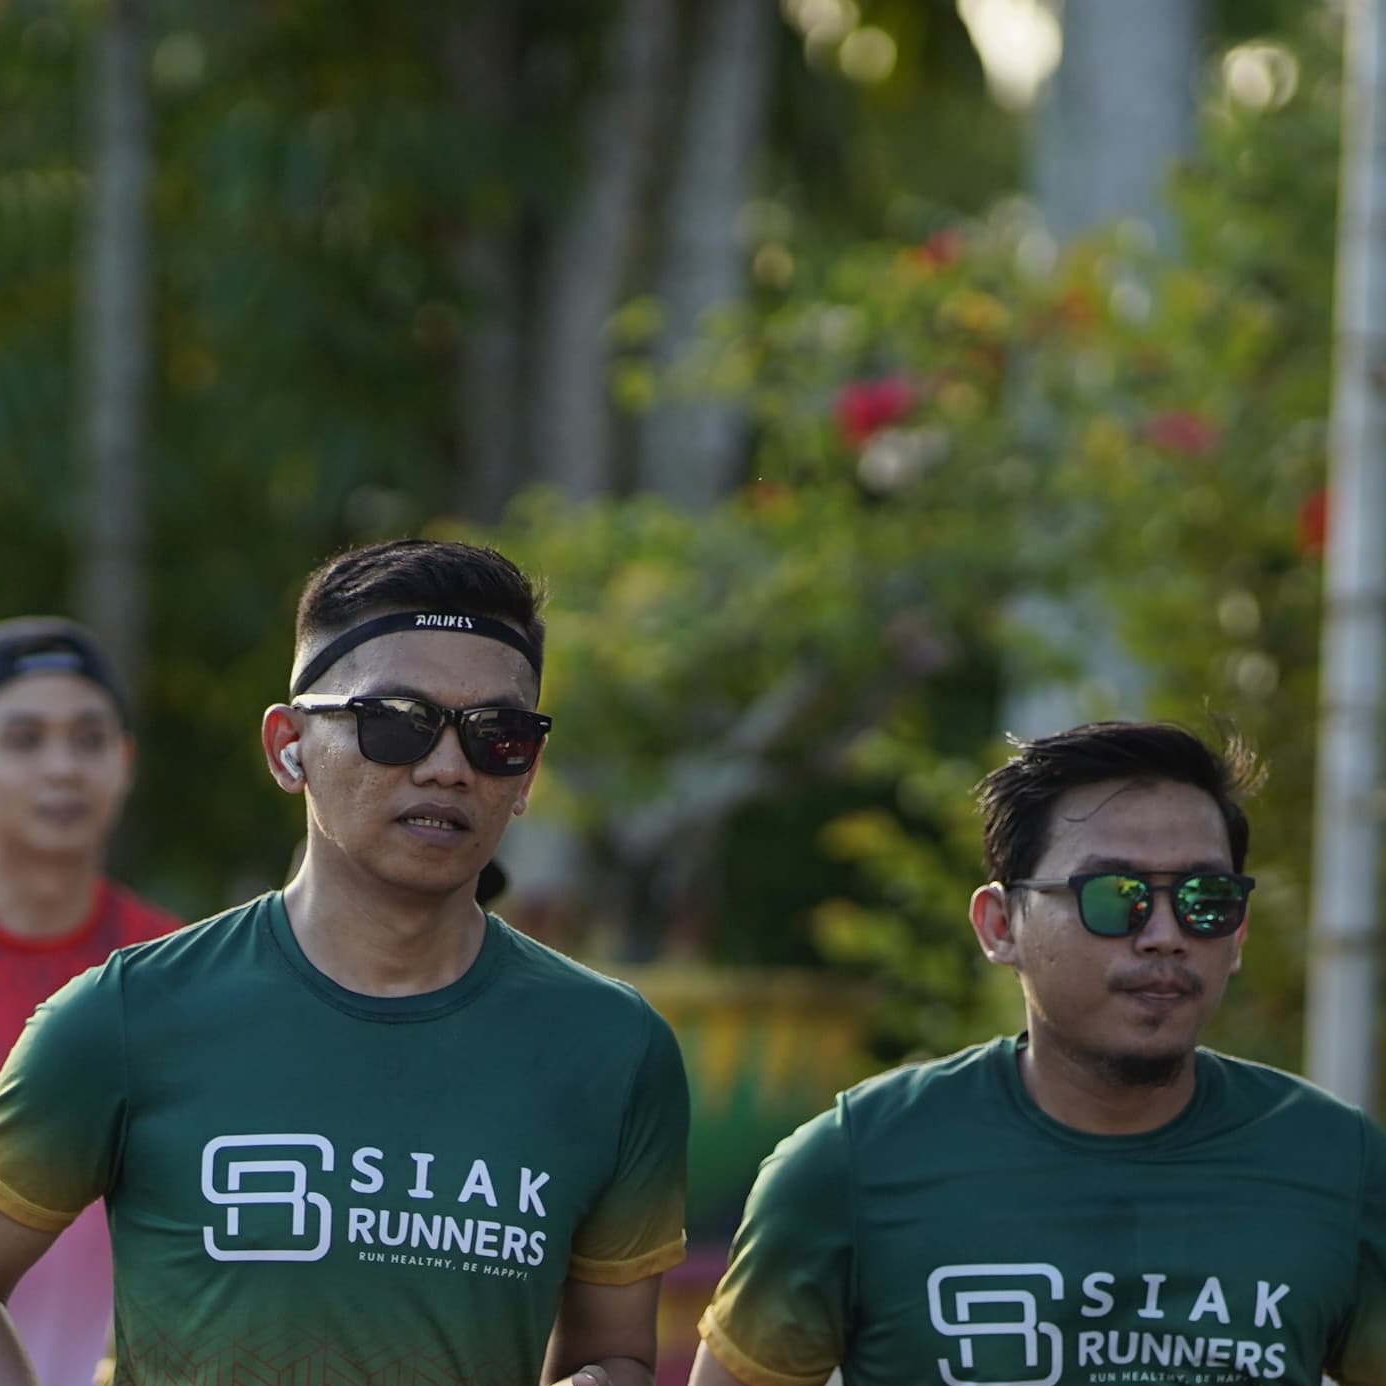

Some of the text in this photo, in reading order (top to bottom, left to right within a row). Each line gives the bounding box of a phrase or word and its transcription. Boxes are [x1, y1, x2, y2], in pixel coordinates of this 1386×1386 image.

[350, 1147, 551, 1217] SIAK
[348, 1207, 547, 1266] RUNNERS
[358, 1251, 529, 1281] RUN HEALTHY, BE HAPPY!
[1080, 1271, 1291, 1329] SIAK
[1077, 1330, 1286, 1379] RUNNERS
[1089, 1371, 1116, 1383] RUN
